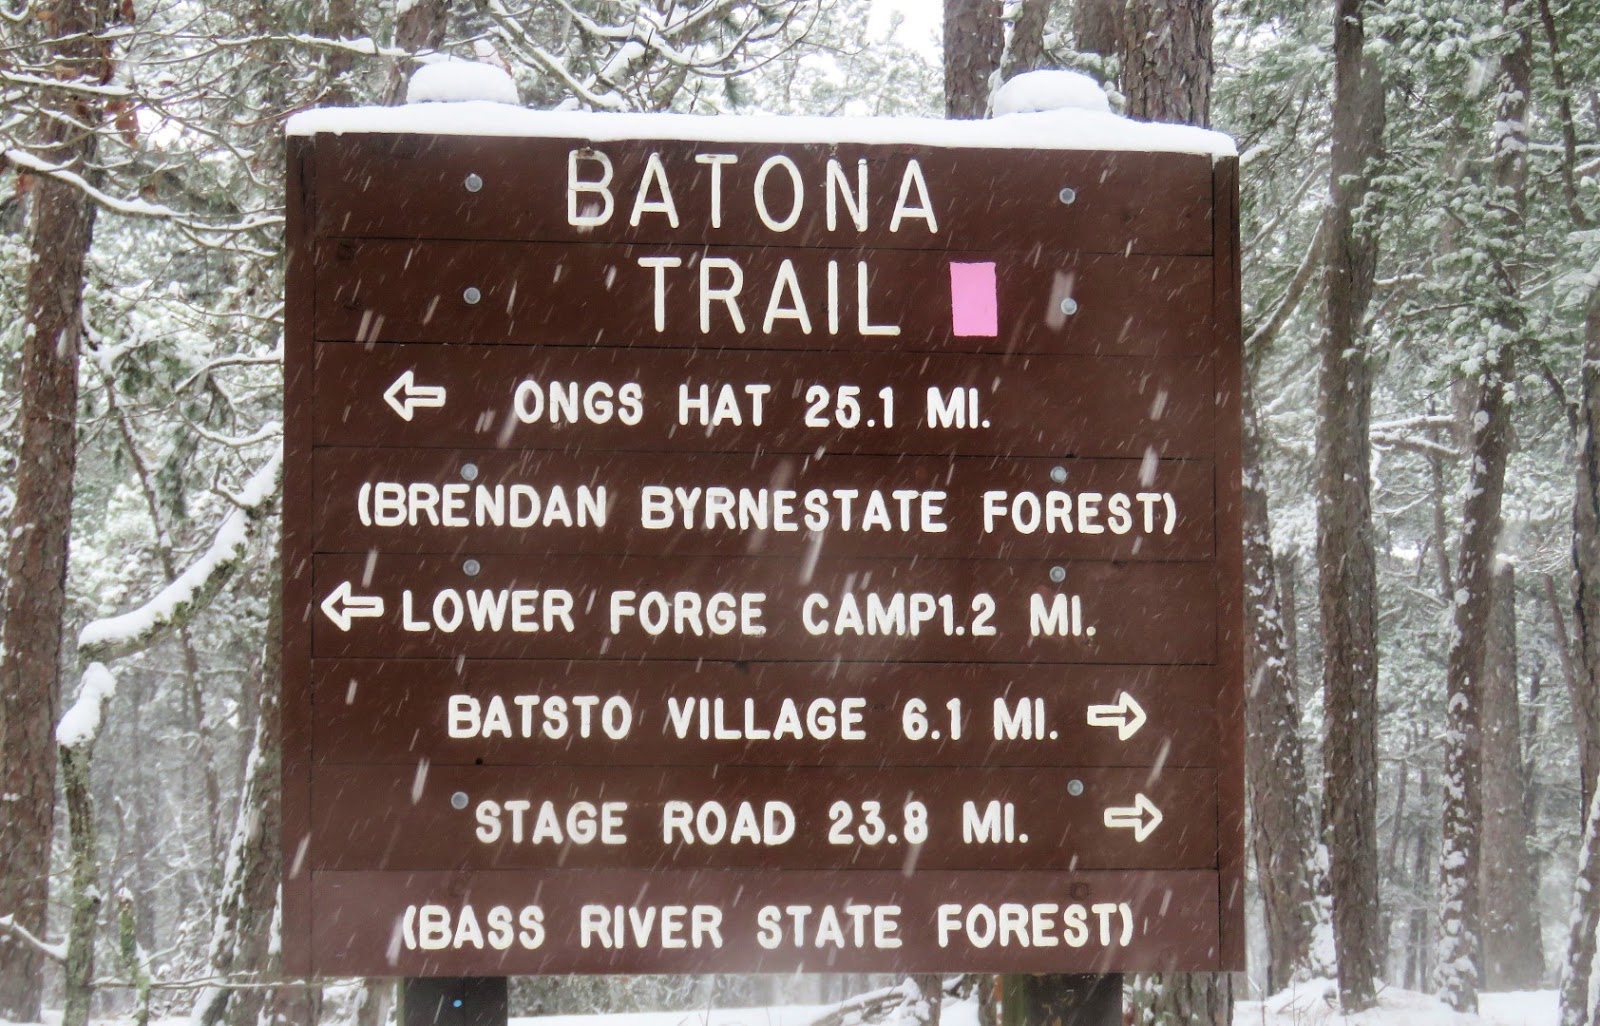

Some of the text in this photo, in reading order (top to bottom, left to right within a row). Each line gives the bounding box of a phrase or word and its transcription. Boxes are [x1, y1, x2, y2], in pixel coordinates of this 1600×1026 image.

[567, 150, 938, 234] BATONA
[637, 256, 901, 336] TRAIL
[513, 379, 990, 429] ONGS HAT 25.1 MI.
[357, 481, 607, 528] (BRENDAN
[983, 490, 1177, 535] FOREST)
[402, 588, 575, 633] LOWER
[610, 590, 767, 636] FORGE
[1030, 593, 1096, 637] MI.
[448, 694, 1058, 741] BATSTO VILLAGE 6.1 MI.
[475, 800, 1029, 846] STAGE ROAD 23.8 MI.
[402, 902, 1134, 950] (BASS RIVER STATE FOREST)
